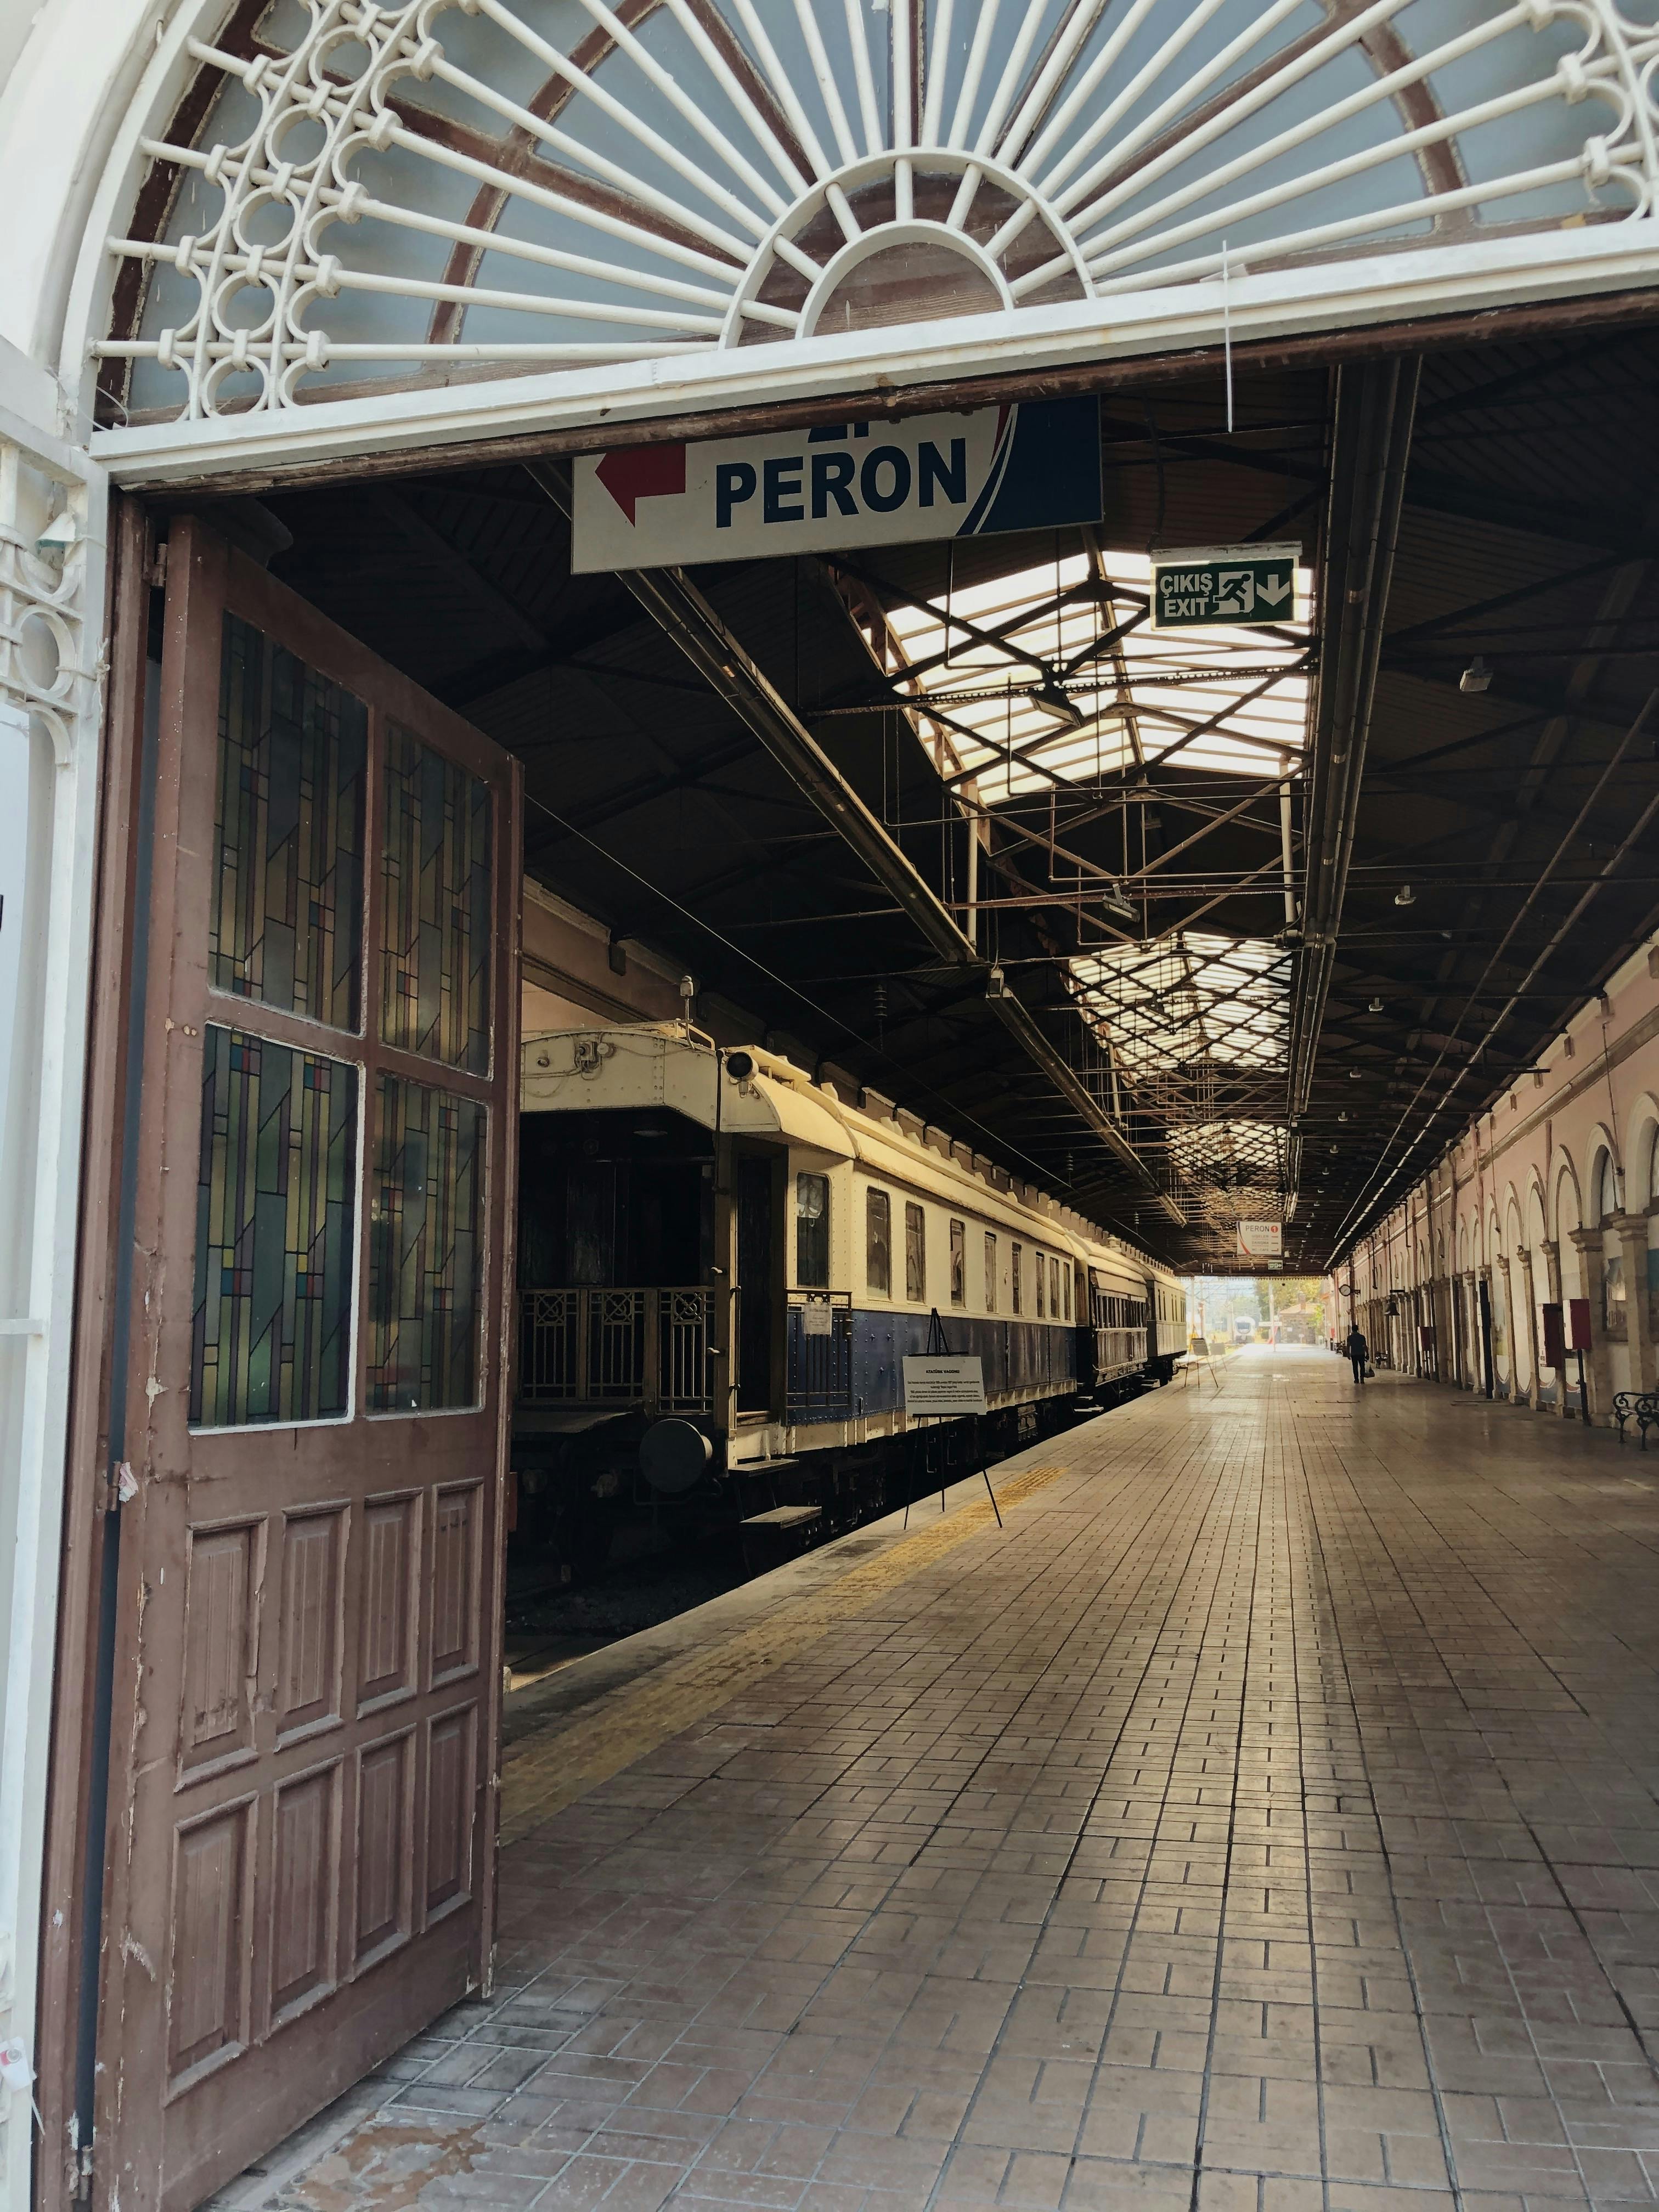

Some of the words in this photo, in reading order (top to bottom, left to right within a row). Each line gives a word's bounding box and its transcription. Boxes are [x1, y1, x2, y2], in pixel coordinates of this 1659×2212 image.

[715, 437, 968, 528] PERON
[1160, 573, 1213, 599] ÇIKIŞ
[1164, 597, 1209, 618] EXIT
